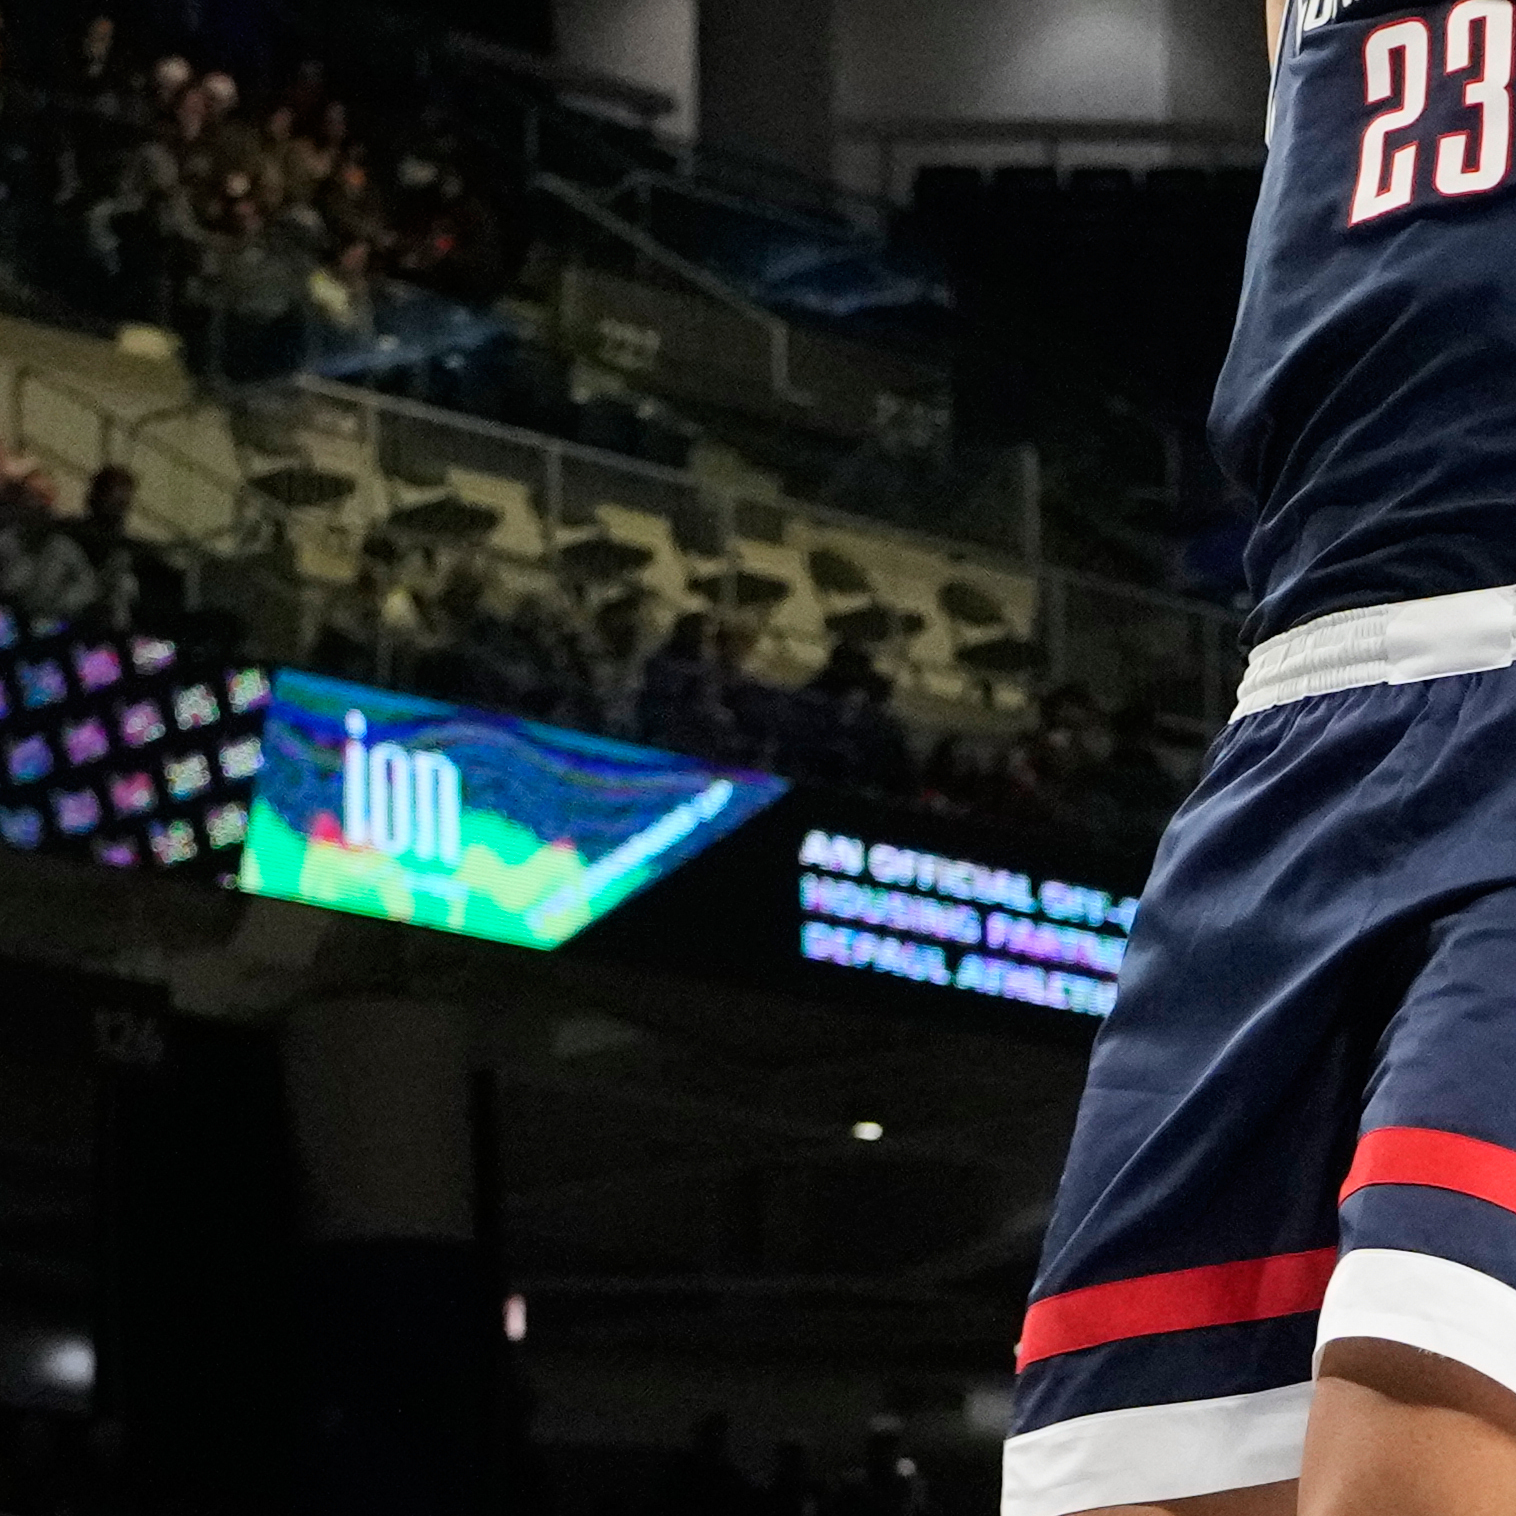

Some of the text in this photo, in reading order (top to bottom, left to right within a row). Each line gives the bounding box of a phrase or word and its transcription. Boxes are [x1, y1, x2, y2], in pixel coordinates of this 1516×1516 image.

[342, 707, 463, 870] ion
[799, 829, 865, 877] AN
[867, 842, 1038, 914] OFFICIAL
[799, 871, 983, 946] HOUSING
[801, 920, 954, 987] DEPAUL
